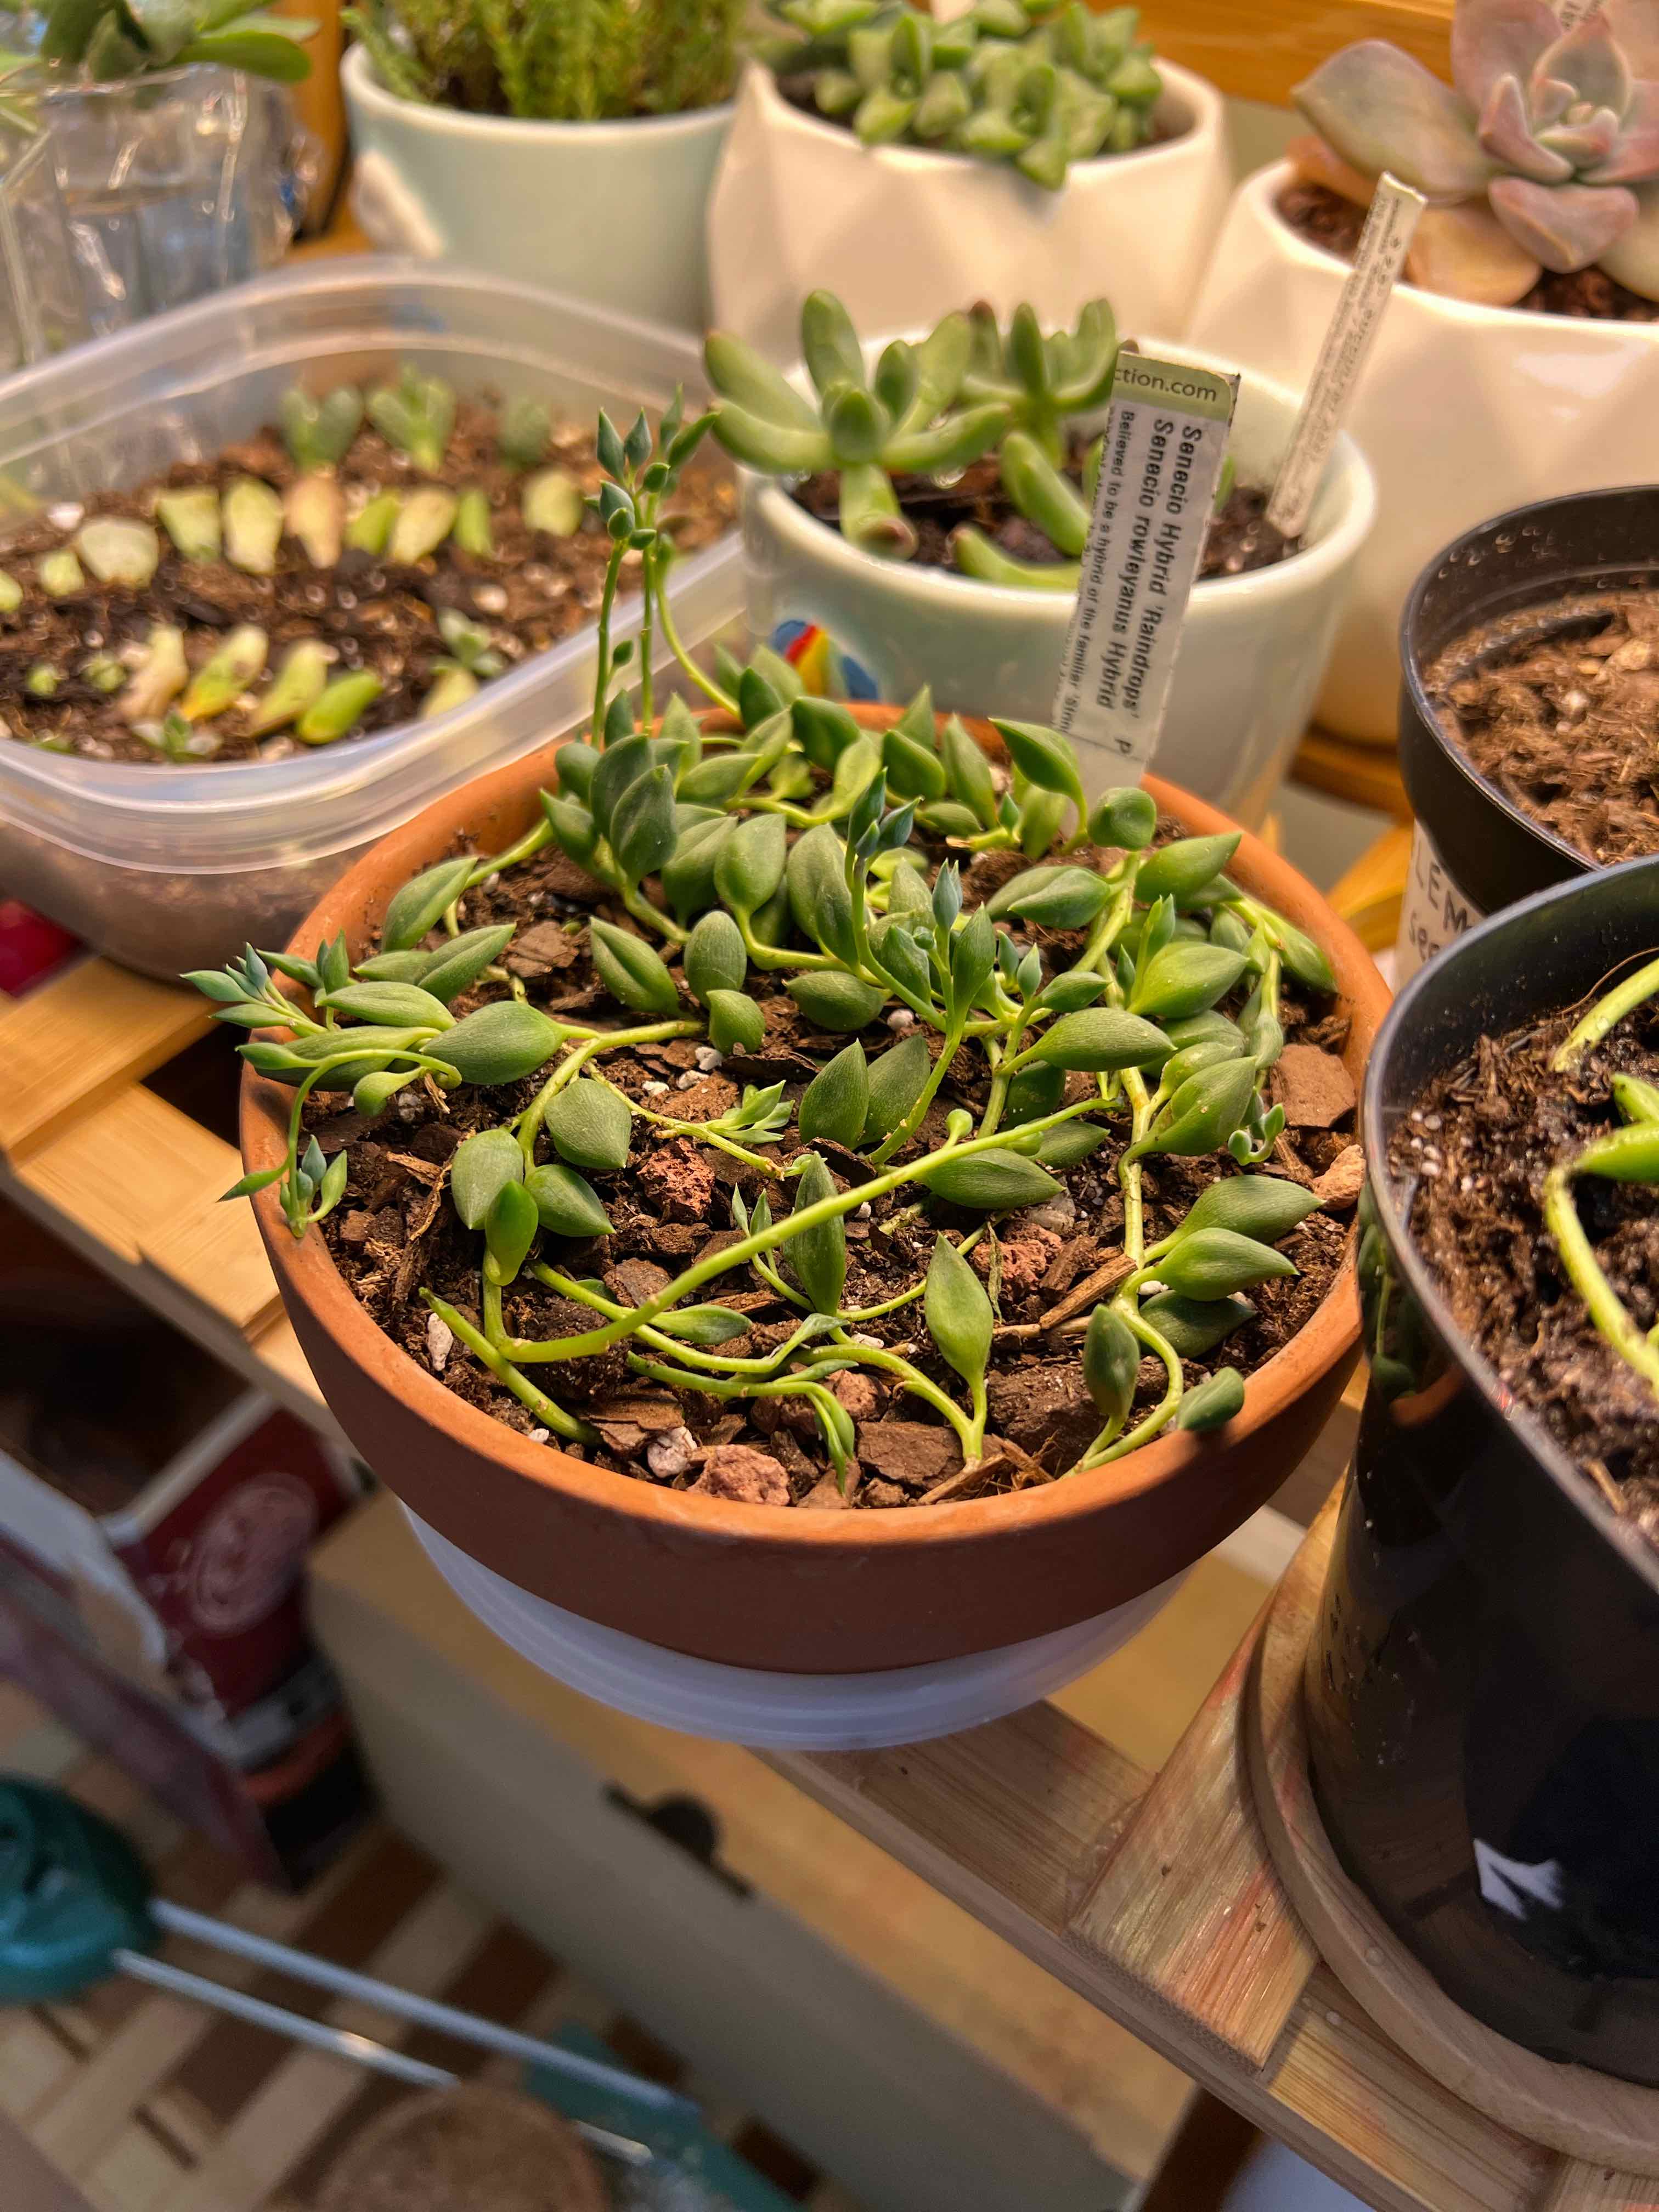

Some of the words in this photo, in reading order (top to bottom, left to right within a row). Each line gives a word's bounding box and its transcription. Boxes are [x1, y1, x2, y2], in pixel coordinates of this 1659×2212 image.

[1111, 411, 1135, 477] Believed
[1138, 419, 1174, 507] Senecio
[1166, 426, 1202, 515] Senecio
[1103, 500, 1118, 519] be
[1107, 481, 1121, 496] to
[1090, 538, 1110, 585] hybrid
[1100, 523, 1110, 533] a
[1149, 522, 1182, 596] Hybrid
[1087, 588, 1098, 603] of
[1113, 515, 1150, 634] rowleyanus
[1080, 607, 1096, 630] the
[1097, 640, 1127, 710] Hybrid
[1122, 606, 1165, 719] 'Raindrops'
[1416, 841, 1474, 934] LEM
